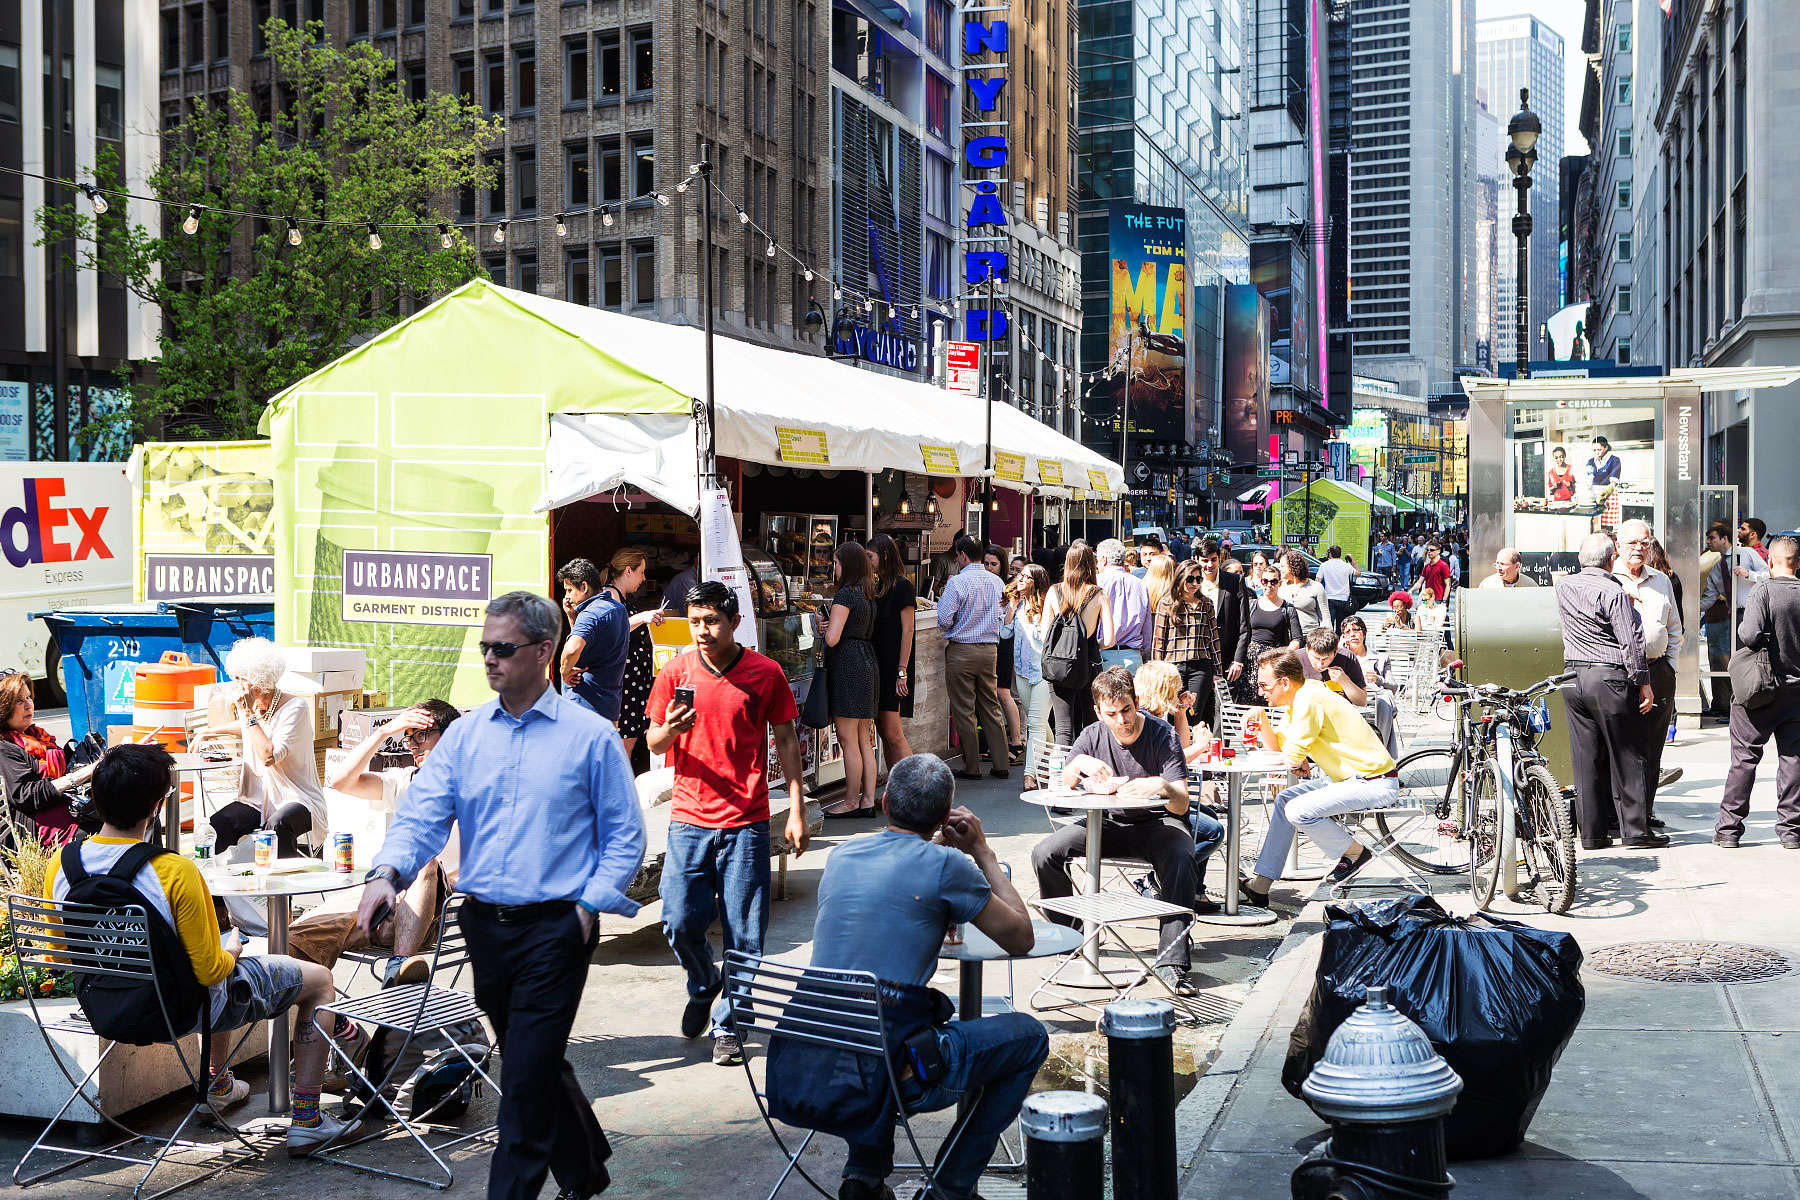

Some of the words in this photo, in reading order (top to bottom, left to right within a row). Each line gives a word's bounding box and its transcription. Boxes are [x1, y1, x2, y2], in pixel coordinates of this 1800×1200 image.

[1124, 212, 1152, 229] THE
[1143, 245, 1172, 256] TOM
[9, 386, 20, 398] SF
[1568, 400, 1612, 408] CEMUSA
[12, 415, 23, 426] SF
[1678, 406, 1692, 481] Newsstand
[0, 478, 115, 568] dEx
[1557, 563, 1576, 573] have
[45, 569, 84, 584] Express
[352, 561, 482, 593] URBANSPACE
[1538, 575, 1549, 586] be
[353, 602, 416, 616] GARMENT
[421, 603, 480, 618] DISTRICT
[108, 640, 141, 658] 2-YD
